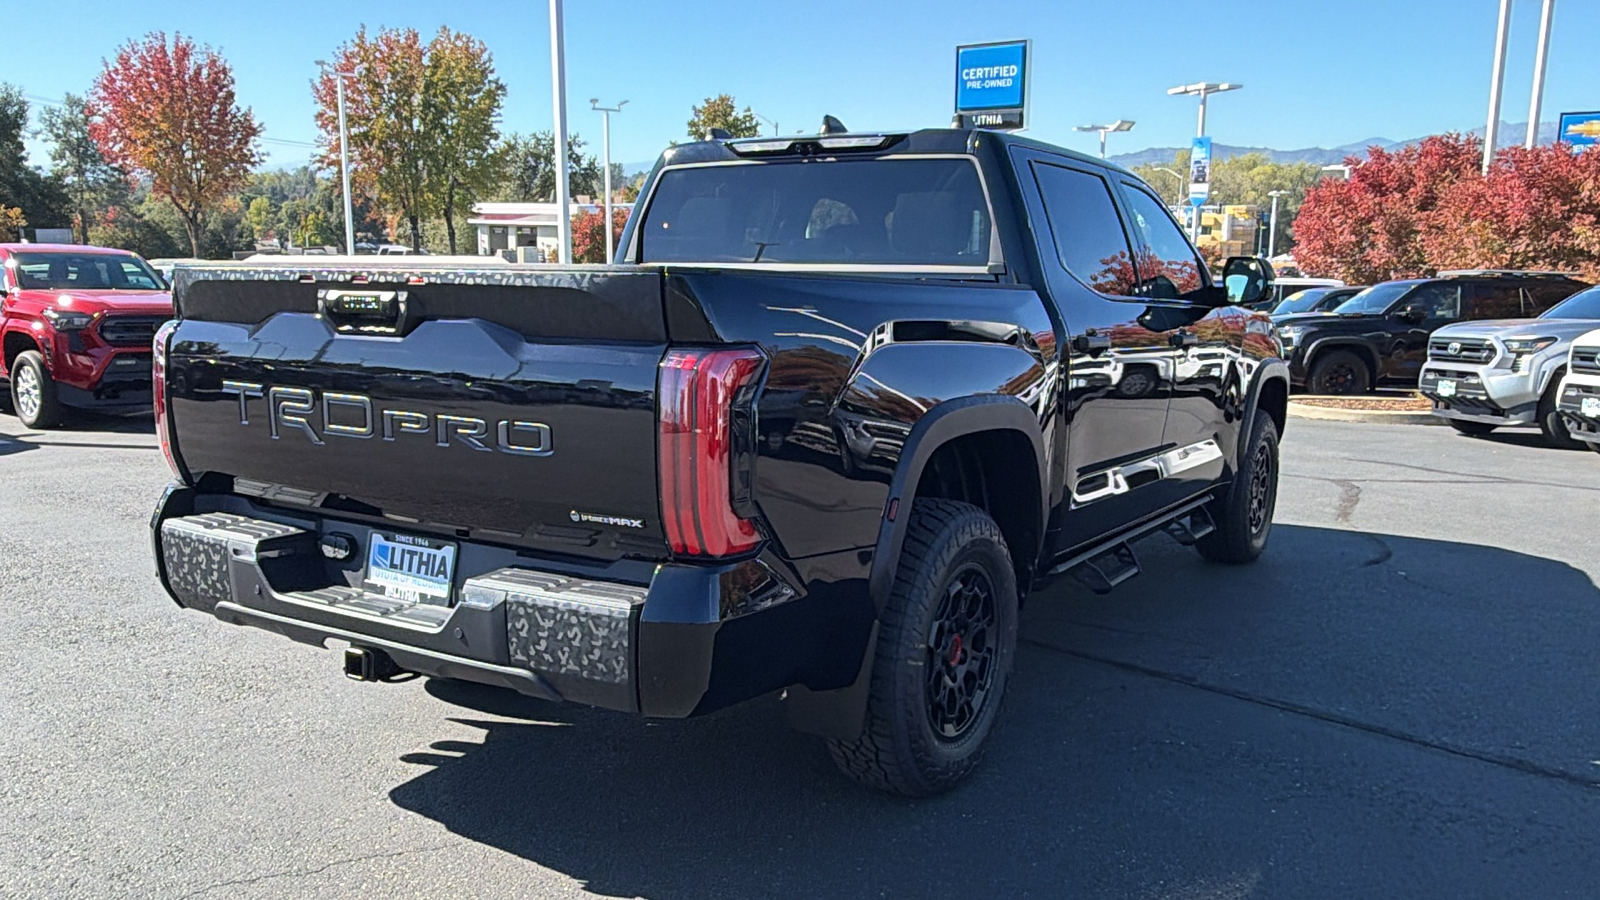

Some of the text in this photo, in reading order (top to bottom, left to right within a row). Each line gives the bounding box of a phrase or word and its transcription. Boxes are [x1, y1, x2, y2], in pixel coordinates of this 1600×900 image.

[962, 66, 1017, 80] CERTIFIED
[967, 79, 1012, 89] PRE-OWNED
[972, 115, 1002, 126] LITHIA
[222, 380, 555, 457] TRD PRO
[395, 534, 428, 546] SINCE 1946
[389, 547, 448, 579] LITHIA
